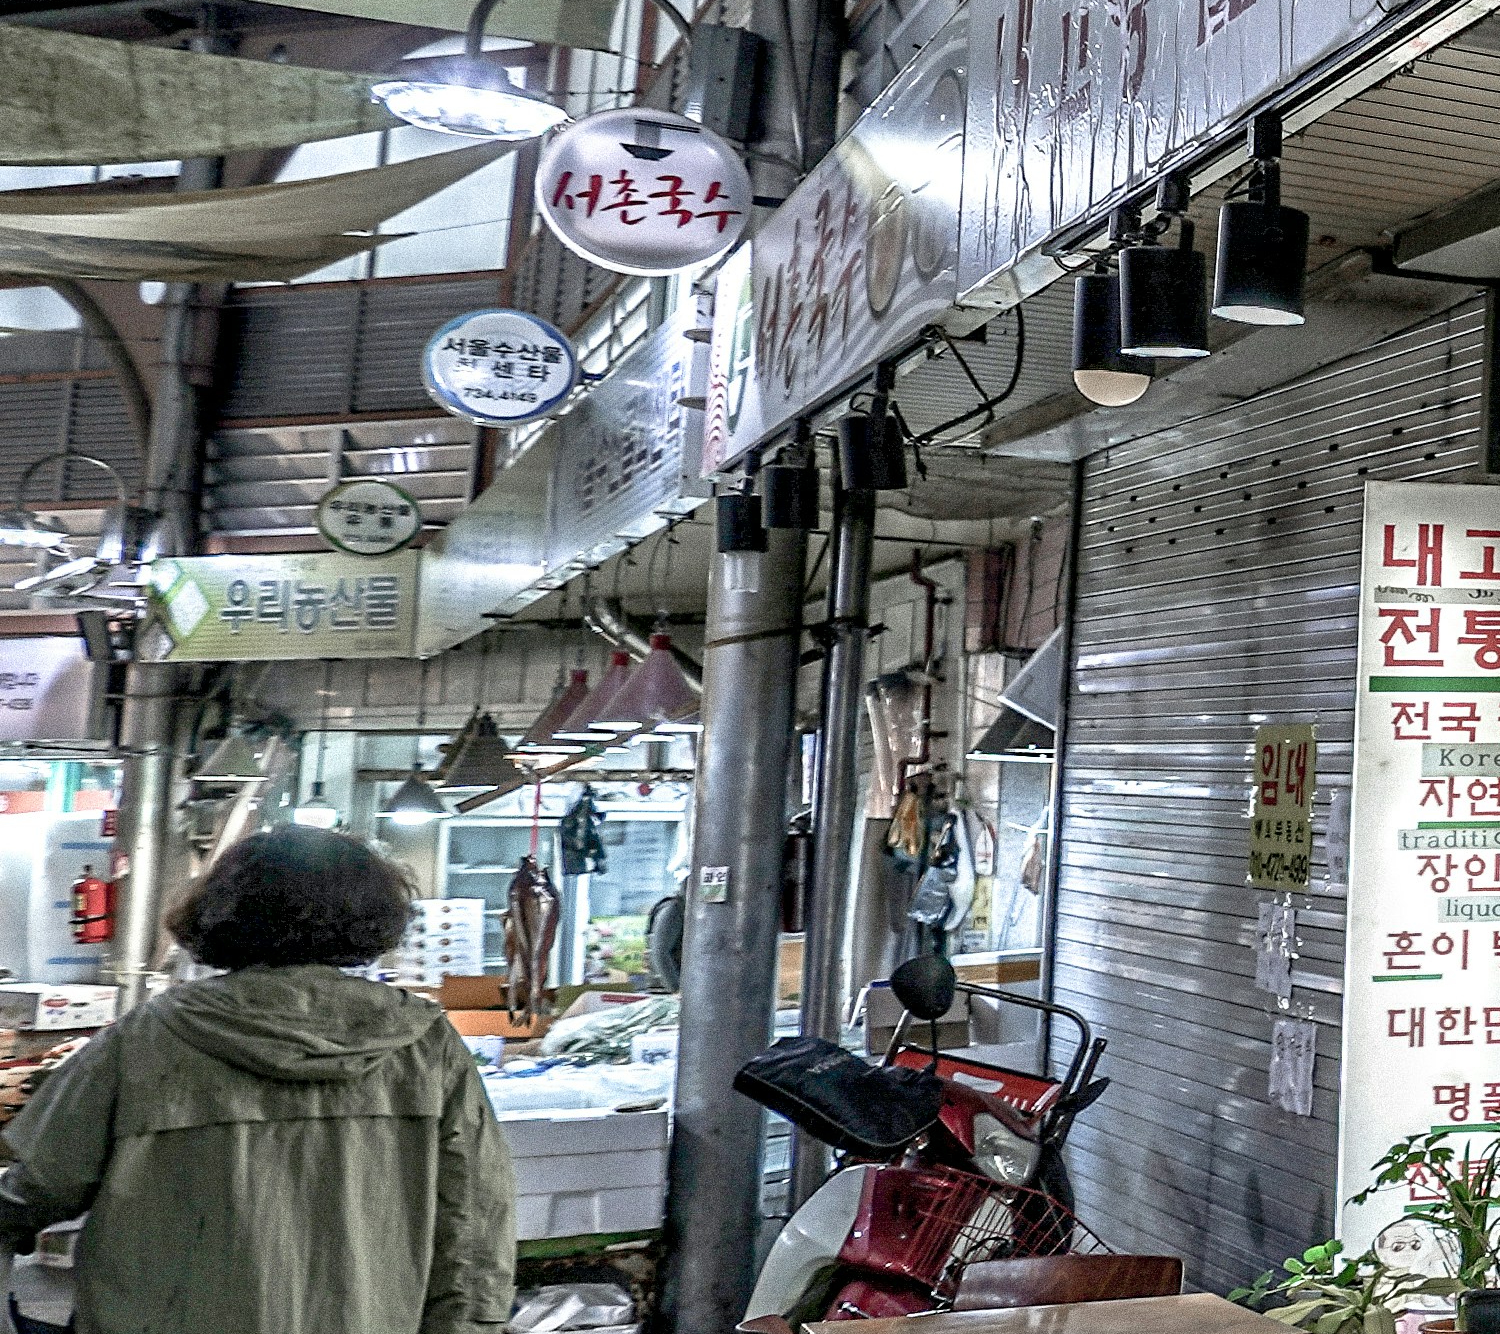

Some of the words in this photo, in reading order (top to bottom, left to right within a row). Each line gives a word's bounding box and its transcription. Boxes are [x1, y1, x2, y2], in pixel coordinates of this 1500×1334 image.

[552, 169, 743, 234] 서촌국수
[220, 575, 399, 636] 우리농산물
[1391, 701, 1481, 743] 전국
[1261, 742, 1308, 808] 임대
[1382, 928, 1470, 970] 혼이
